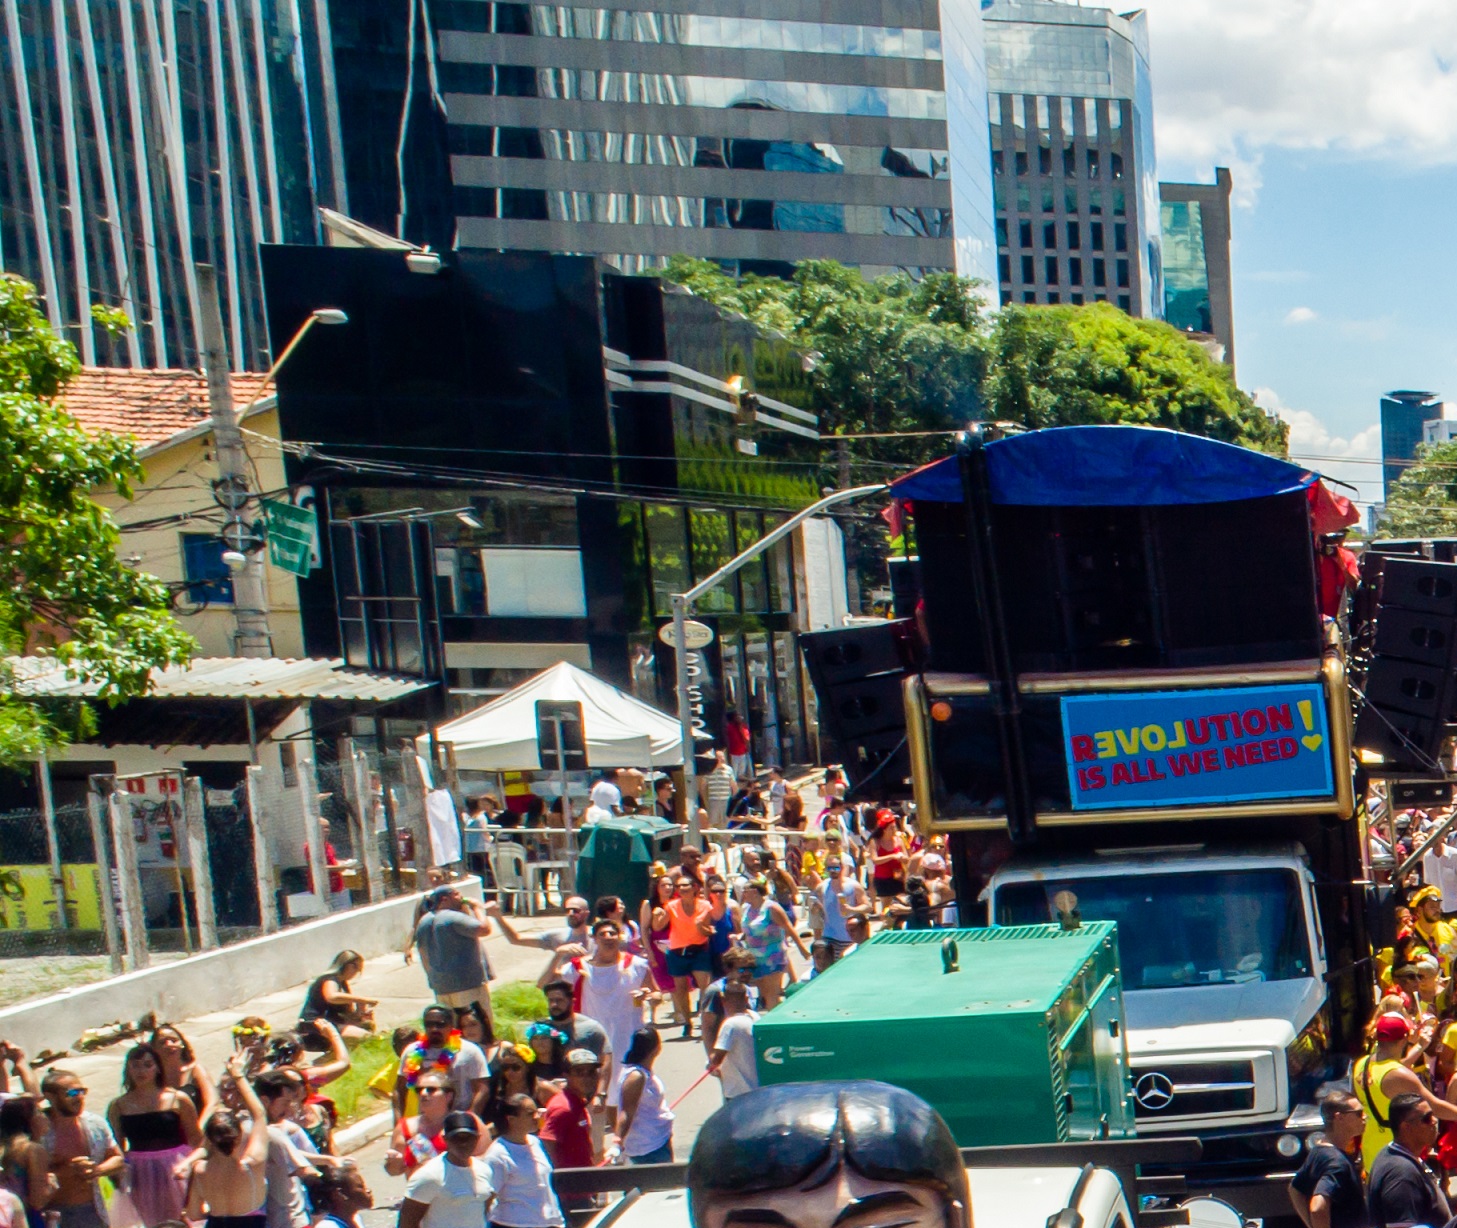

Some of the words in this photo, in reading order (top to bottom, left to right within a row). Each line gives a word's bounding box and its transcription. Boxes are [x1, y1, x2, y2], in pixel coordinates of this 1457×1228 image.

[1077, 765, 1107, 791] IS
[1111, 759, 1166, 786] ALL
[1166, 750, 1221, 777] WE
[1223, 736, 1300, 769] NEED
